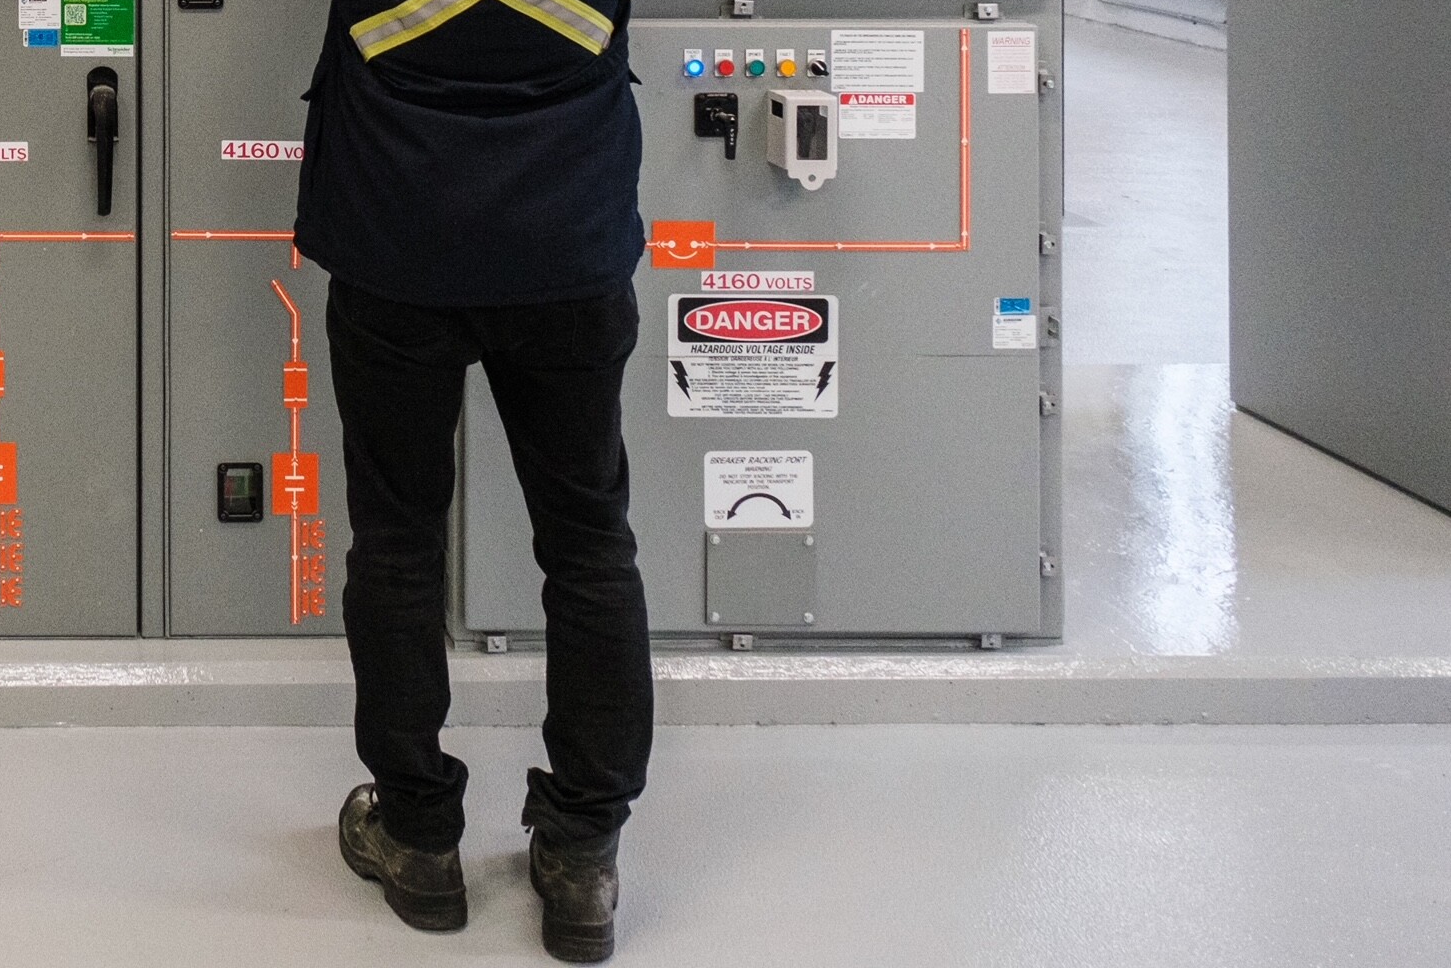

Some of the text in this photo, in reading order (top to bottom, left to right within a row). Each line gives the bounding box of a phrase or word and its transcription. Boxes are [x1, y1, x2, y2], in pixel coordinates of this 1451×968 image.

[991, 37, 1031, 46] WARNING
[858, 95, 907, 104] DANGER
[222, 142, 280, 158] 4160
[703, 273, 813, 290] 4160 VOLTS
[696, 310, 811, 331] DANGER
[691, 344, 815, 354] HAZARDOUS VOLTAGE INSIDE
[710, 456, 807, 464] BREAKER RACKING PORT
